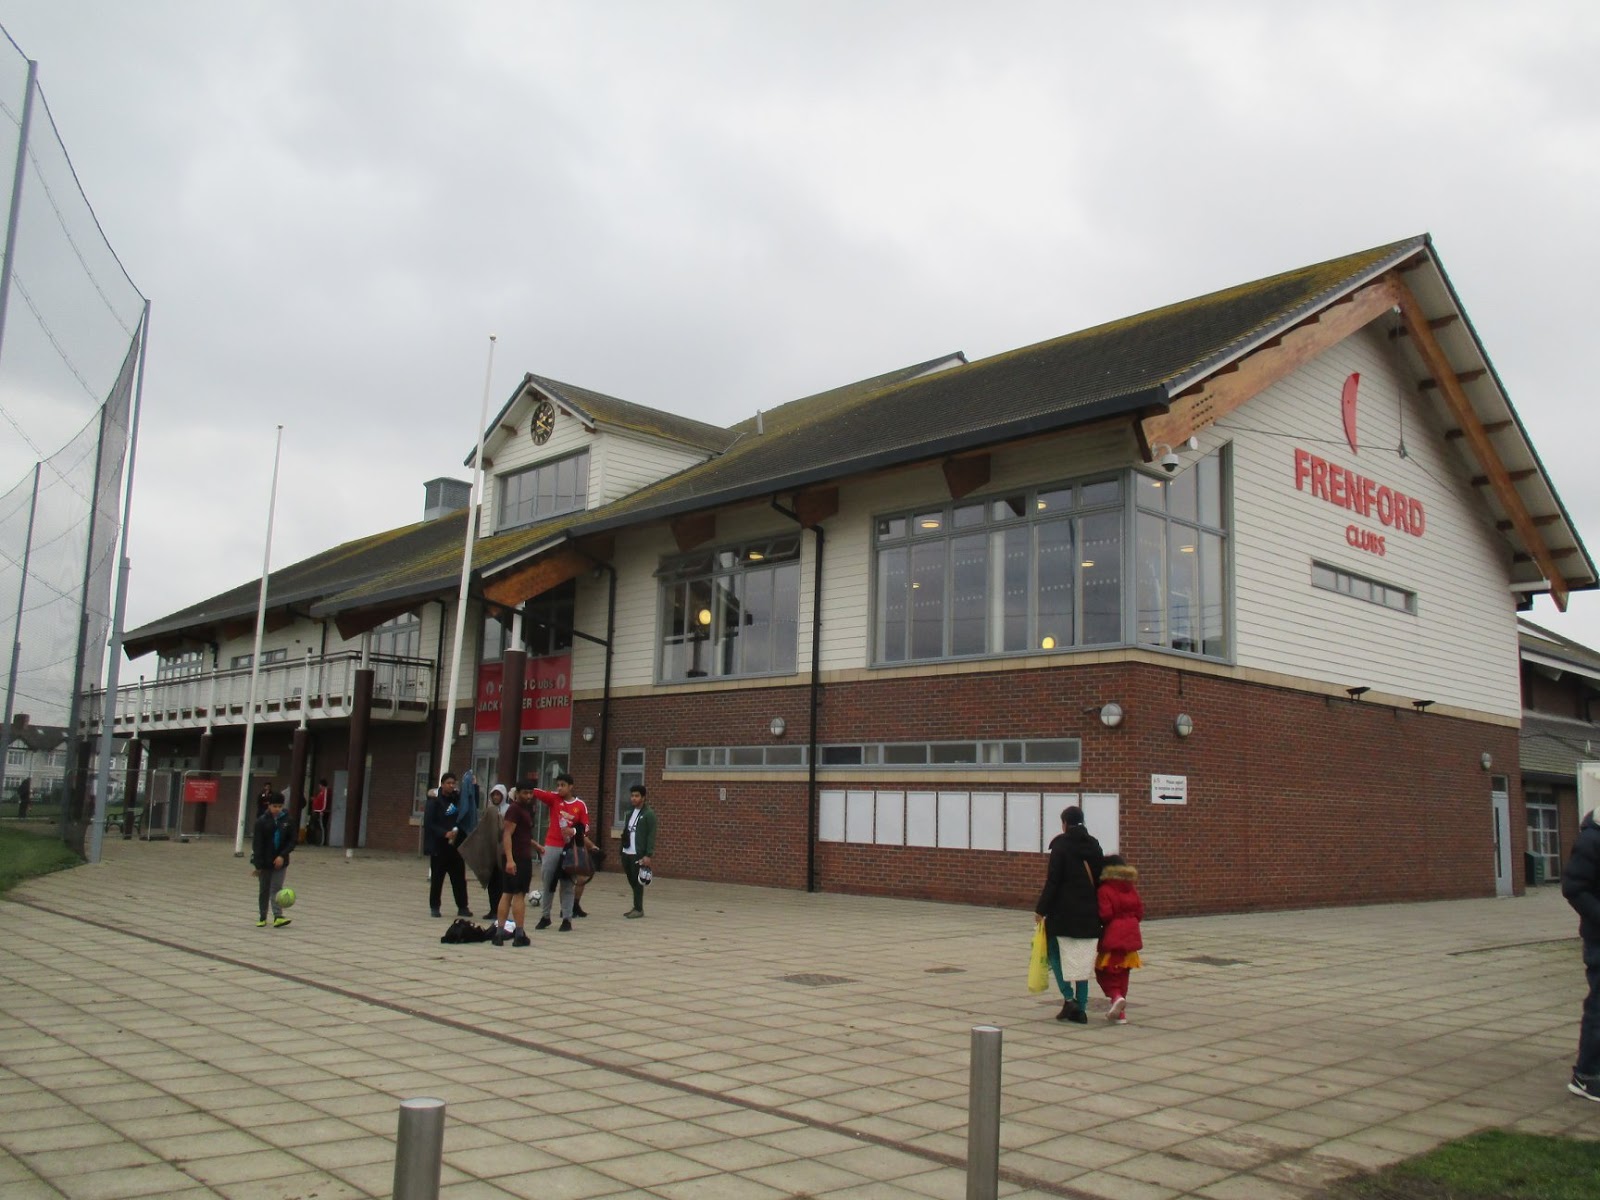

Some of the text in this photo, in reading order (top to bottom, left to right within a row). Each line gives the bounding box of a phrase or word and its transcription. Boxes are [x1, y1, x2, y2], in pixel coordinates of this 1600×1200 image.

[1295, 448, 1425, 537] FRENFORD
[1346, 525, 1385, 556] CLUBS
[529, 678, 554, 690] CUBS
[478, 700, 499, 712] JACK
[535, 695, 569, 709] CENTRE
